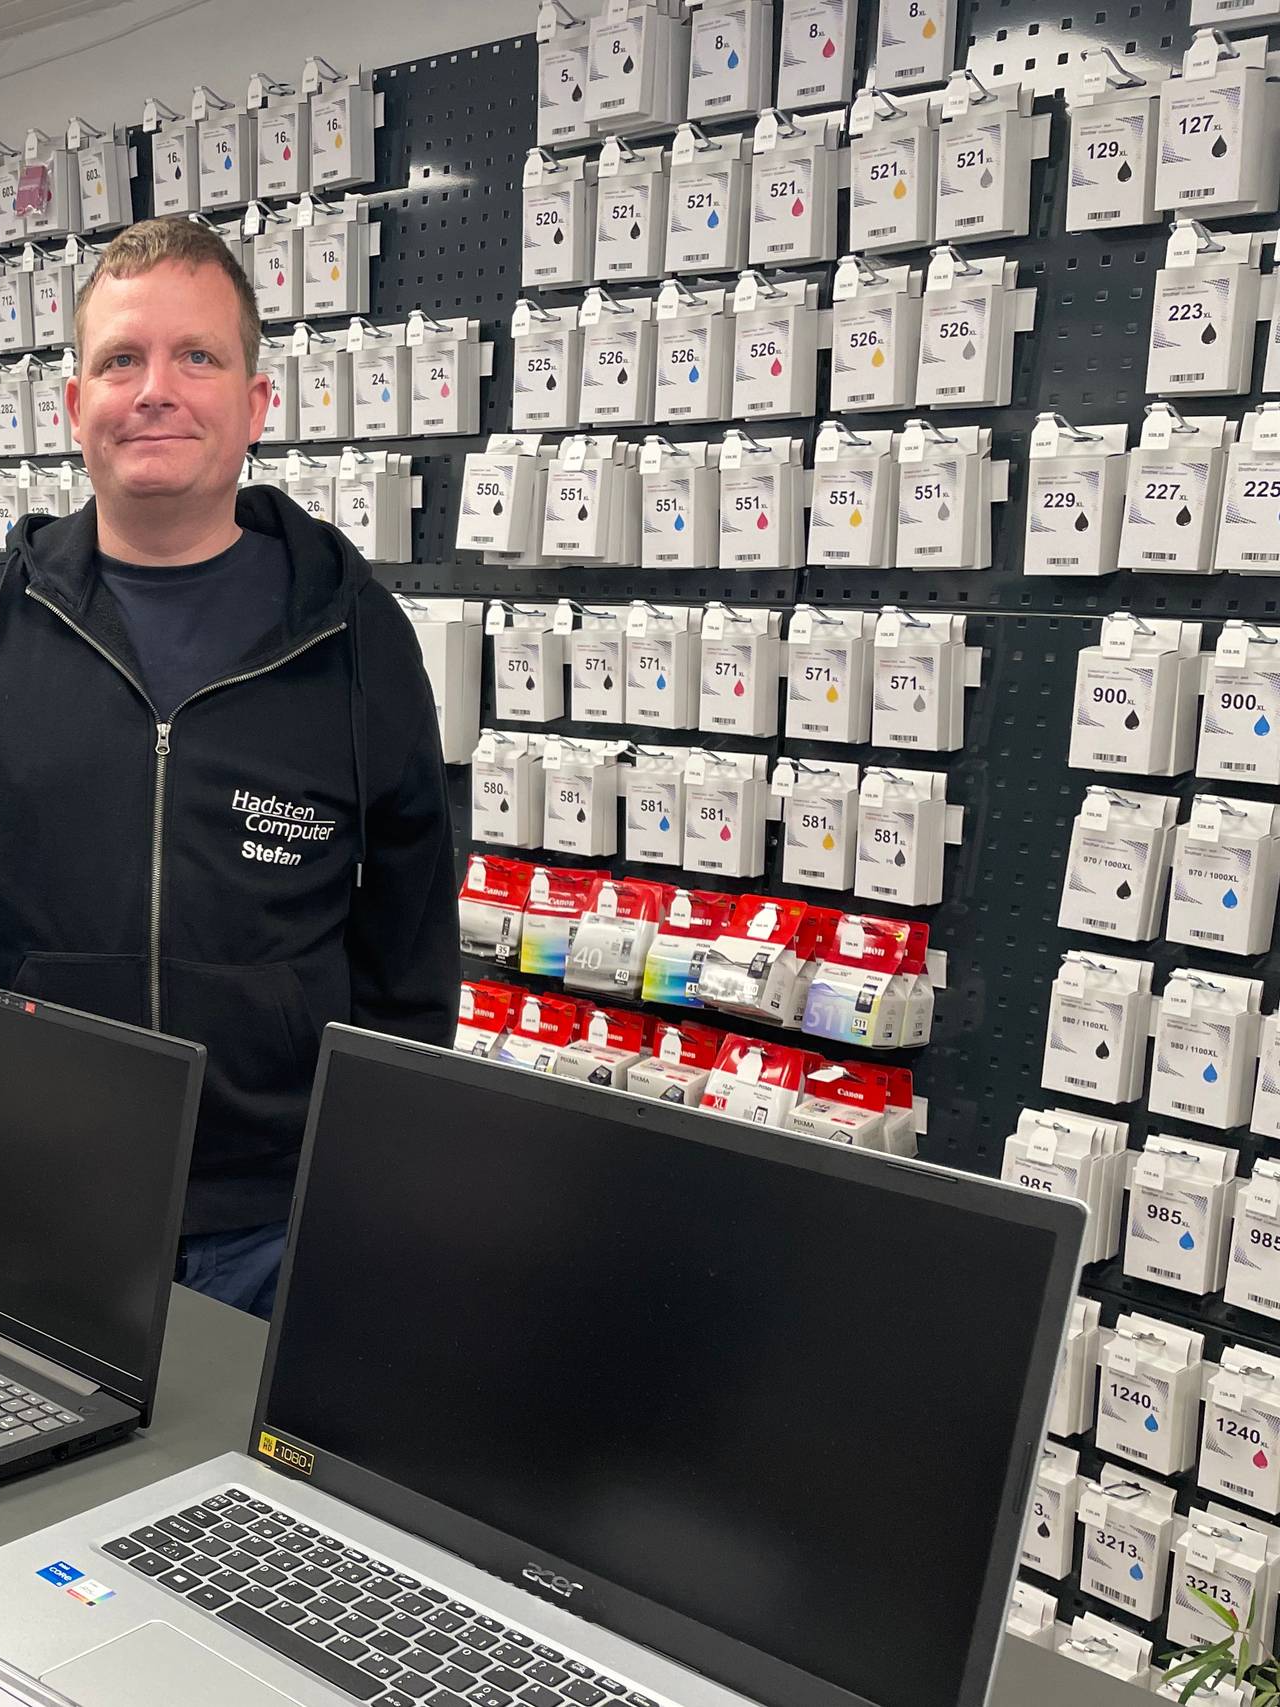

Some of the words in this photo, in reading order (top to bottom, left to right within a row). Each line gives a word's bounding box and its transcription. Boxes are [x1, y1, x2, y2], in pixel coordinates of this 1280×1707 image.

[1179, 115, 1223, 135] 127XL
[1087, 141, 1128, 160] 129XL
[1168, 303, 1212, 322] 223XL
[1043, 492, 1084, 509] 229XL
[1145, 483, 1188, 501] 227XL
[1093, 687, 1136, 706] 900XL
[1221, 693, 1266, 711] 900XL
[232, 789, 315, 821] Hadsten
[245, 814, 334, 842] Computer
[241, 840, 302, 866] Stefan
[574, 948, 602, 970] 40
[617, 970, 627, 981] 40
[854, 1018, 866, 1028] 511
[837, 1087, 864, 1100] Canon
[1147, 1204, 1190, 1228] 985XL
[280, 1446, 307, 1469] 1080
[523, 1561, 583, 1597] acer
